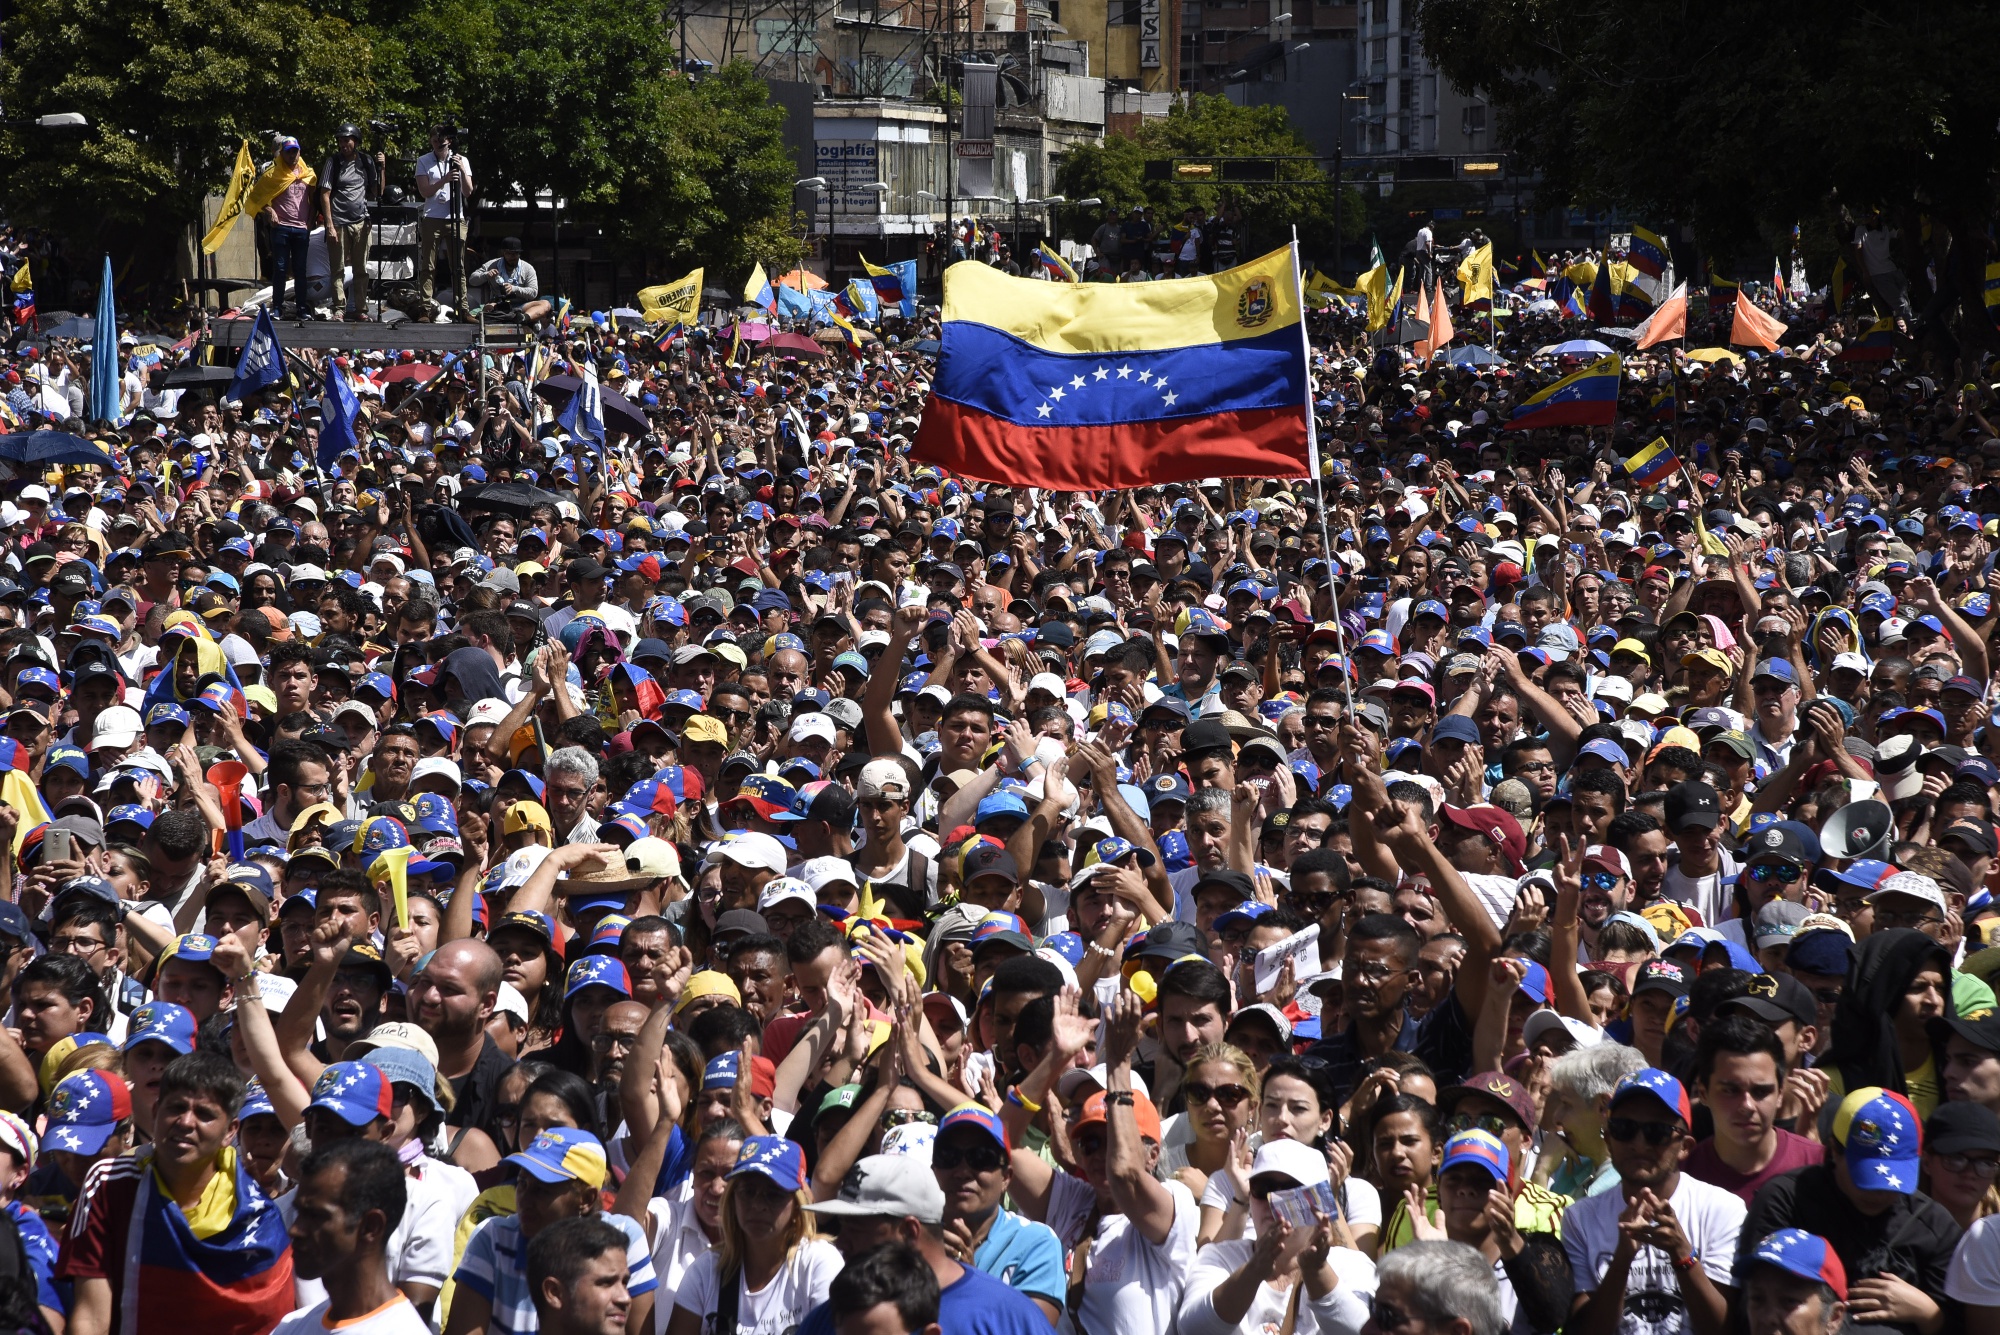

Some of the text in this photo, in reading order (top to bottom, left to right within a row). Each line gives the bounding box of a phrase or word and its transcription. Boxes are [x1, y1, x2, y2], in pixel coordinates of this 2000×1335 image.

[959, 143, 992, 155] FARMACIA
[213, 595, 225, 606] NY
[50, 748, 86, 765] Leones
